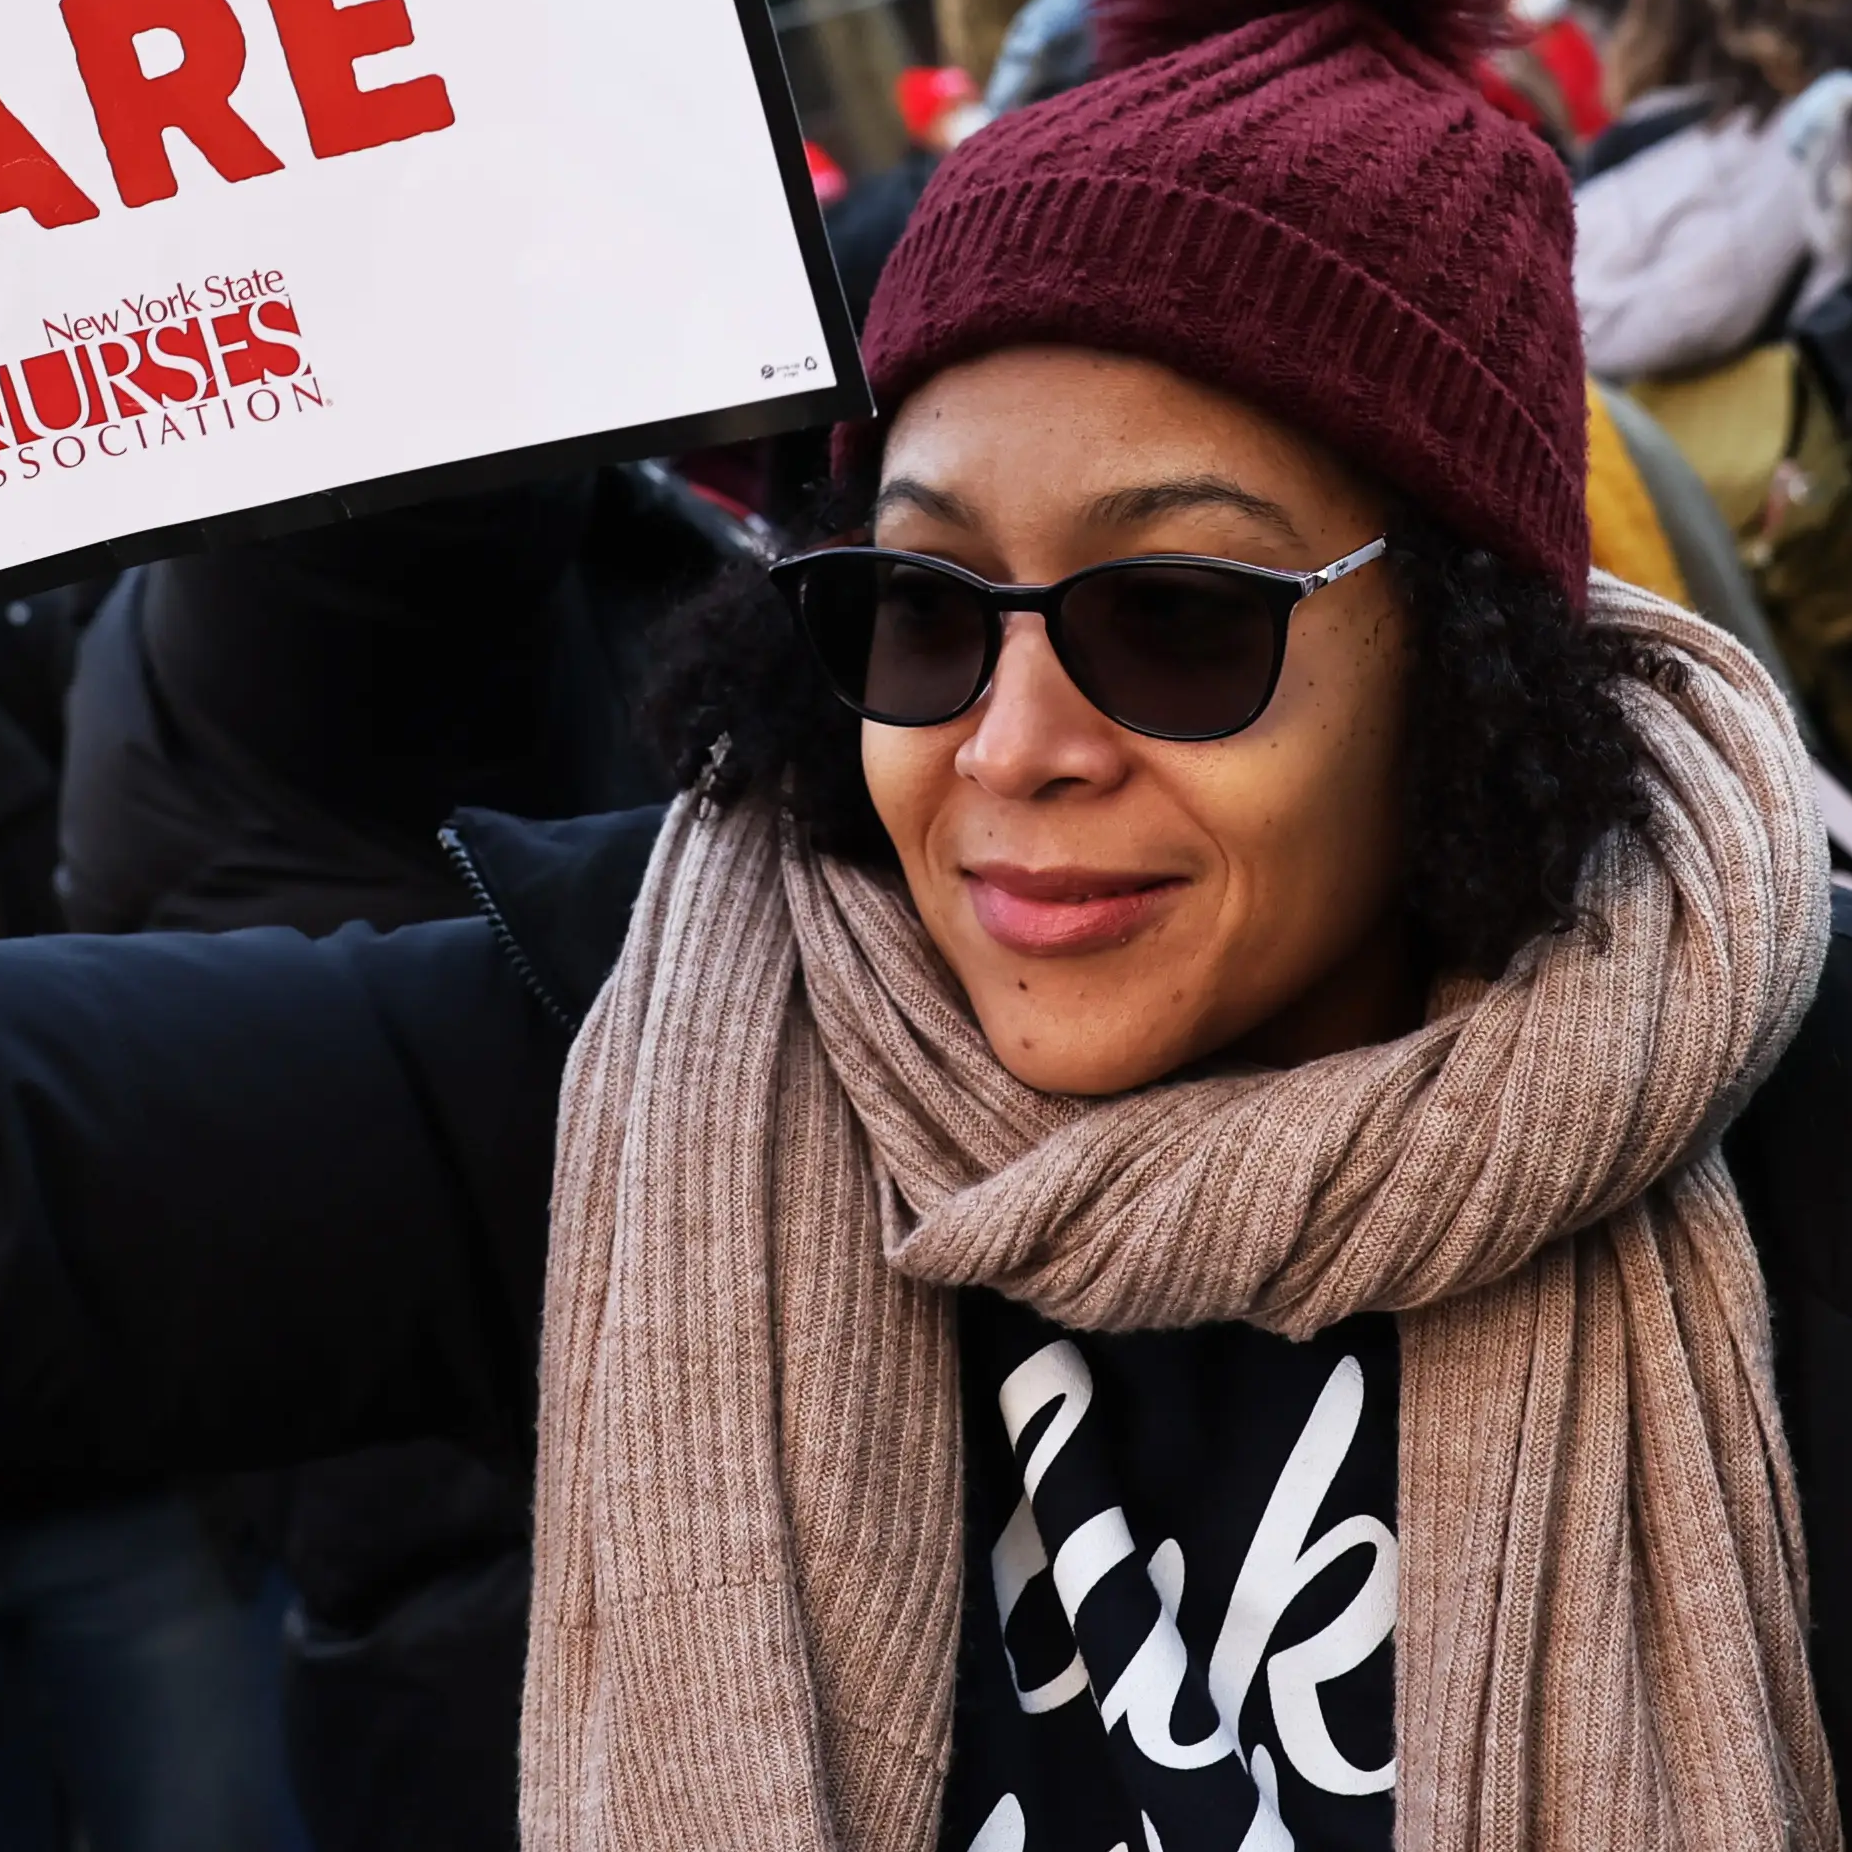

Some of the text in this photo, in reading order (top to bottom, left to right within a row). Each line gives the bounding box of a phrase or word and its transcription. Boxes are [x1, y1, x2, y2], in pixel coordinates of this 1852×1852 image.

[42, 269, 286, 348] New York State
